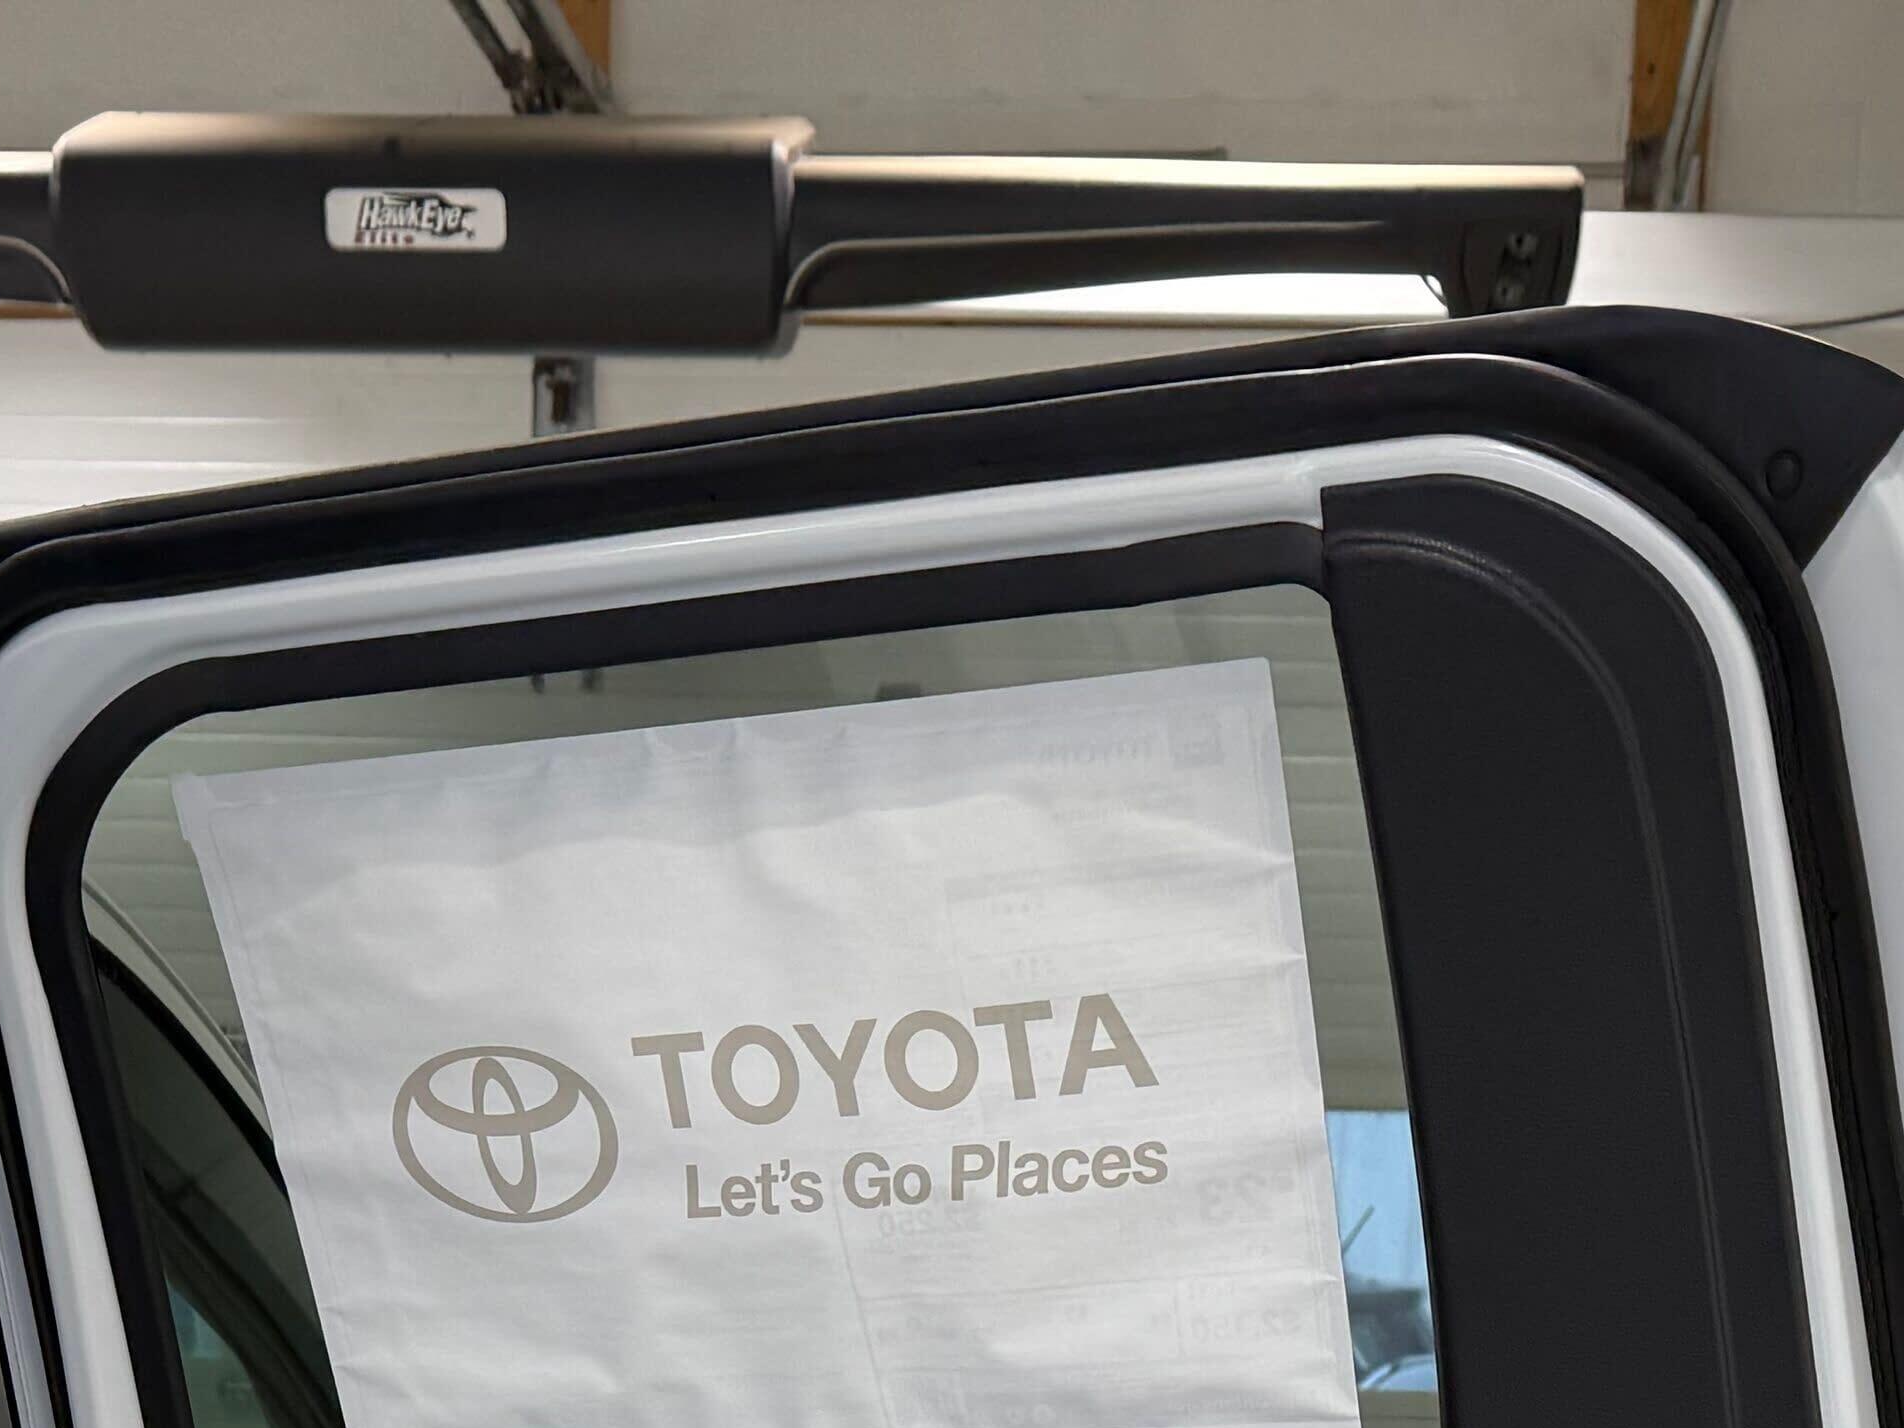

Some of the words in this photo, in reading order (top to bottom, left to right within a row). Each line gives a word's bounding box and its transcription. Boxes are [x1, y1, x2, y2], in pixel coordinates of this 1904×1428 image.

[359, 195, 464, 235] HawkEye
[631, 993, 1160, 1129] TOYOTA
[685, 1159, 825, 1219] Let's
[842, 1151, 933, 1209] Go
[950, 1140, 1168, 1201] Places
